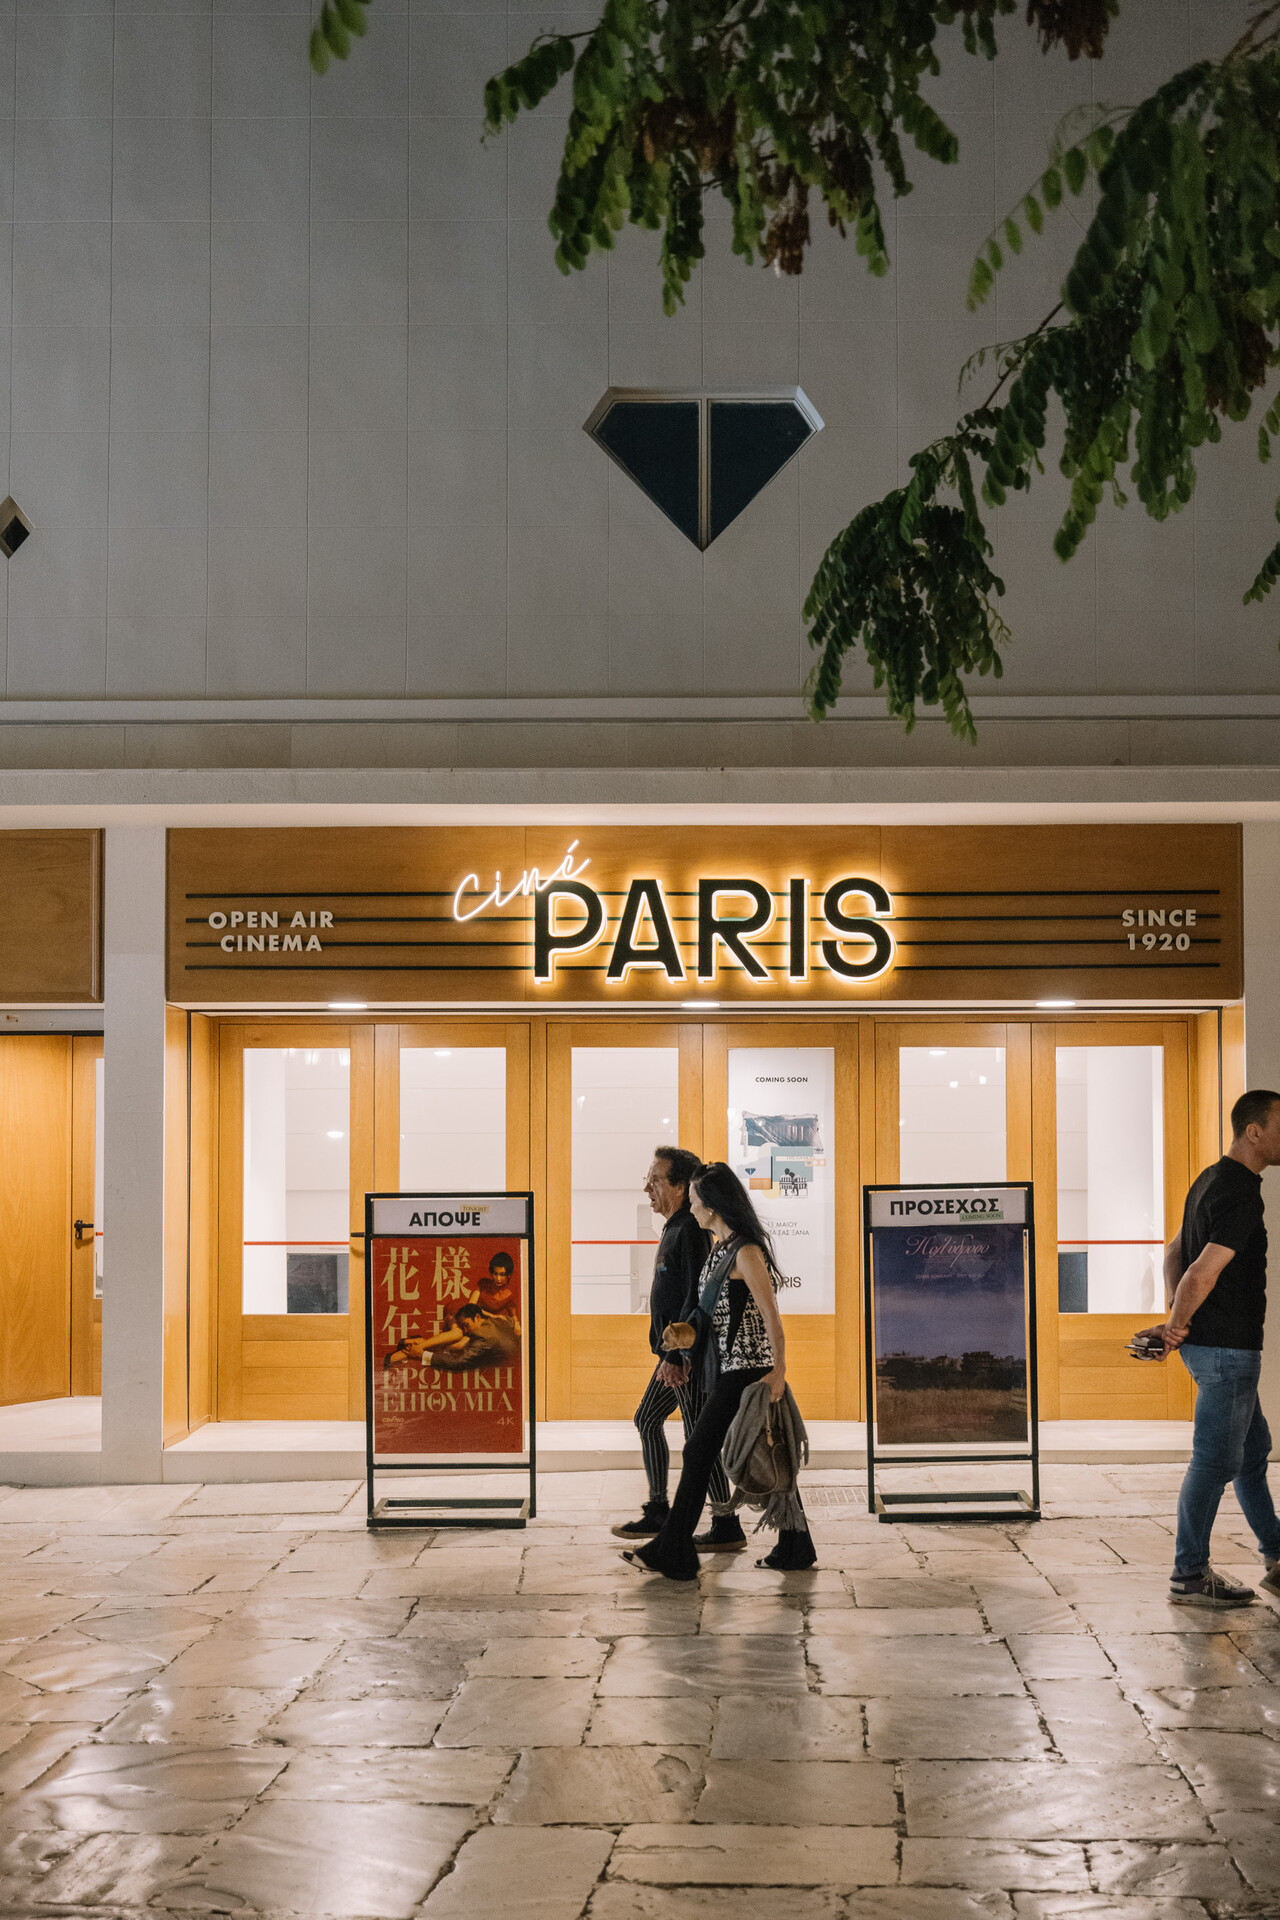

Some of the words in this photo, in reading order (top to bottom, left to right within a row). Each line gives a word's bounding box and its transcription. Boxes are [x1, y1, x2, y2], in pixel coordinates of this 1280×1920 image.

[208, 910, 279, 930] OPEN
[289, 910, 335, 929] AIR
[1121, 908, 1197, 928] SINCE
[534, 876, 896, 984] PARIS
[220, 934, 323, 953] CINEMA
[1127, 932, 1191, 952] 1920
[890, 1198, 1000, 1216] ΠΡΟΣΕΧΩΣ
[408, 1211, 481, 1227] ΑΠΟΨΕ
[382, 1366, 515, 1390] ΕΡΩΤΙΚΗ
[382, 1391, 516, 1412] ΕΠΙΘΥΜΙΑ
[496, 1416, 515, 1426] 4K
